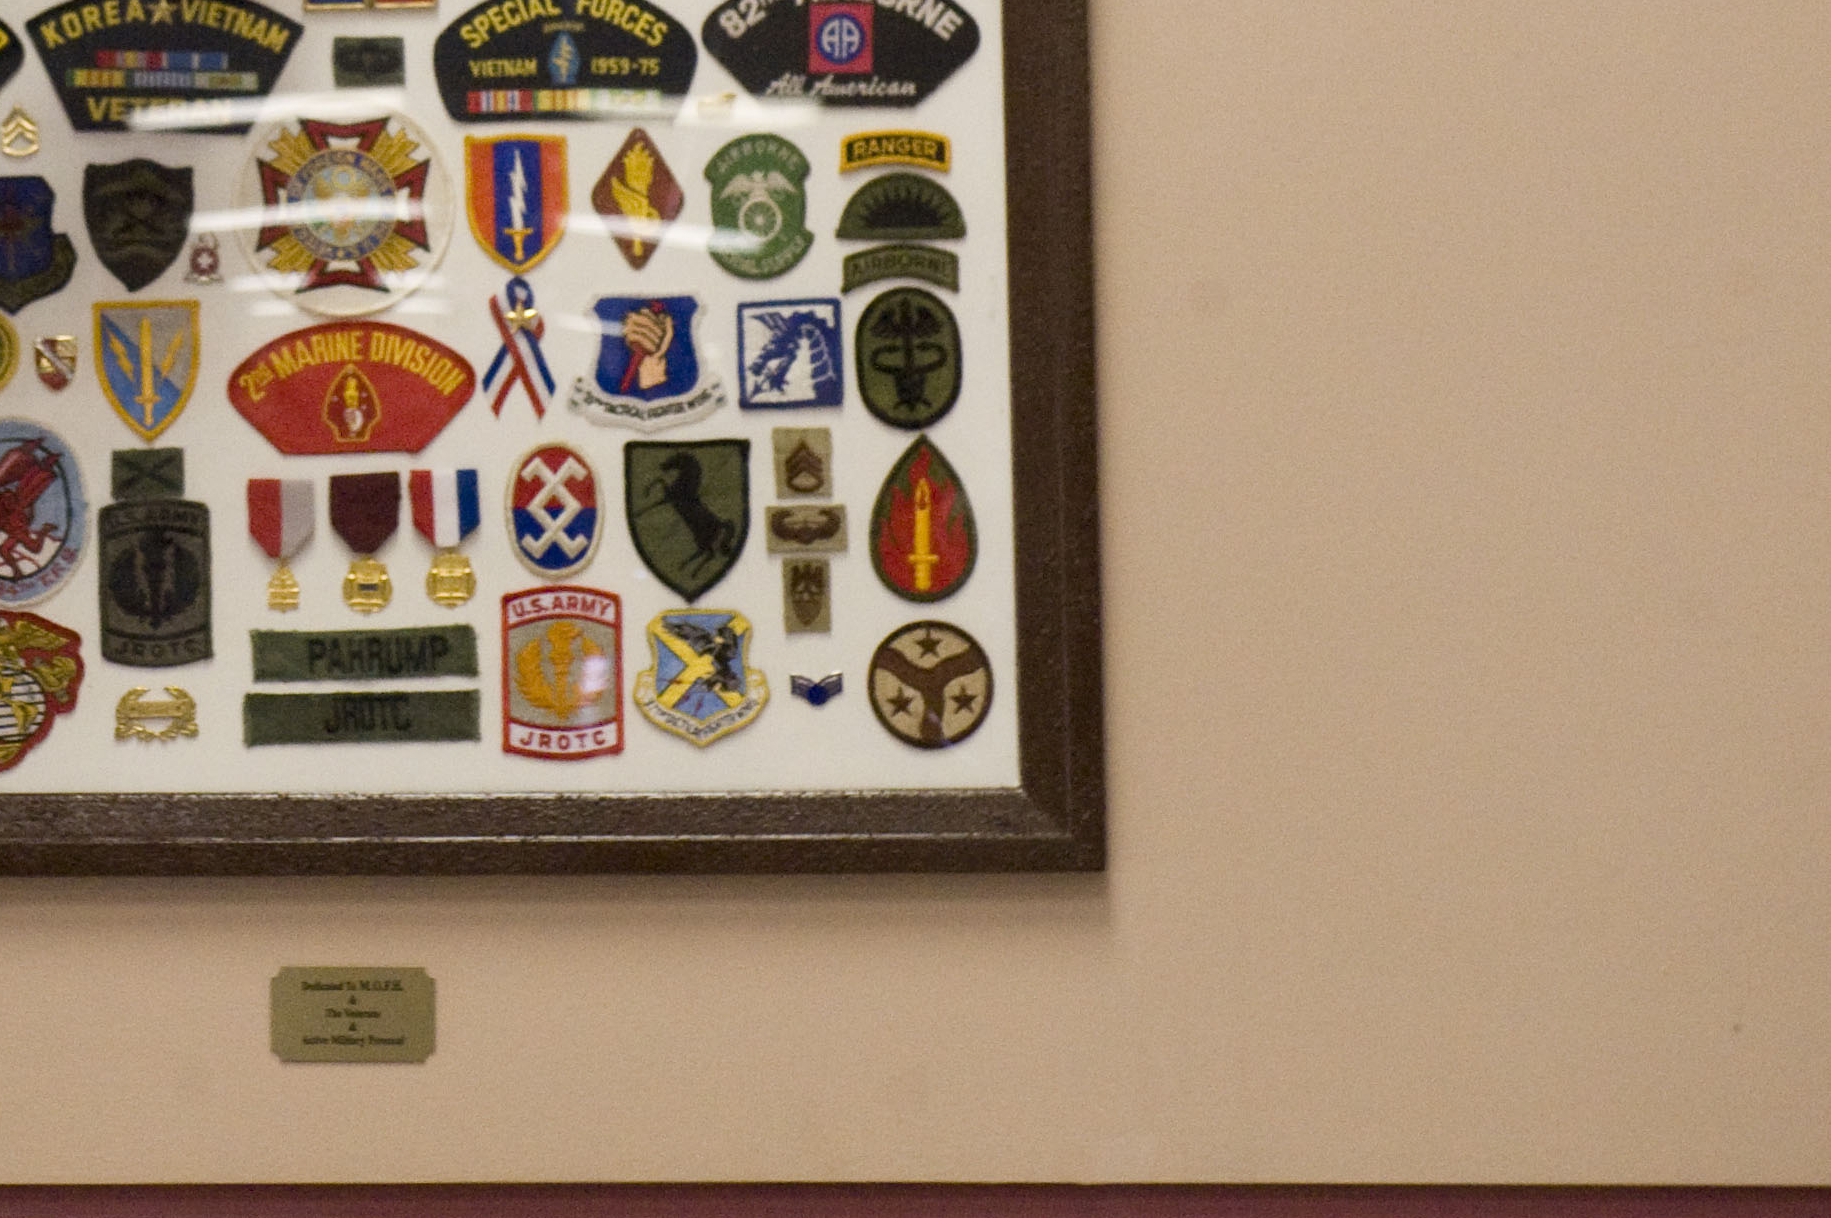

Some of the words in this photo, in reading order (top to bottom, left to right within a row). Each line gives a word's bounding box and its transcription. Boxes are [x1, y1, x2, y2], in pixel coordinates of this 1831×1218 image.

[469, 58, 538, 79] VIETNAM
[590, 56, 660, 76] 1959-75
[812, 73, 918, 98] American
[852, 137, 938, 160] RANGER
[270, 331, 364, 380] MARINE
[370, 331, 467, 397] DIVISION
[511, 597, 548, 618] U.S.
[551, 595, 611, 615] ARMY
[307, 636, 450, 675] PAHRUMP
[324, 695, 412, 734] JROTC
[520, 730, 607, 750] JROTC
